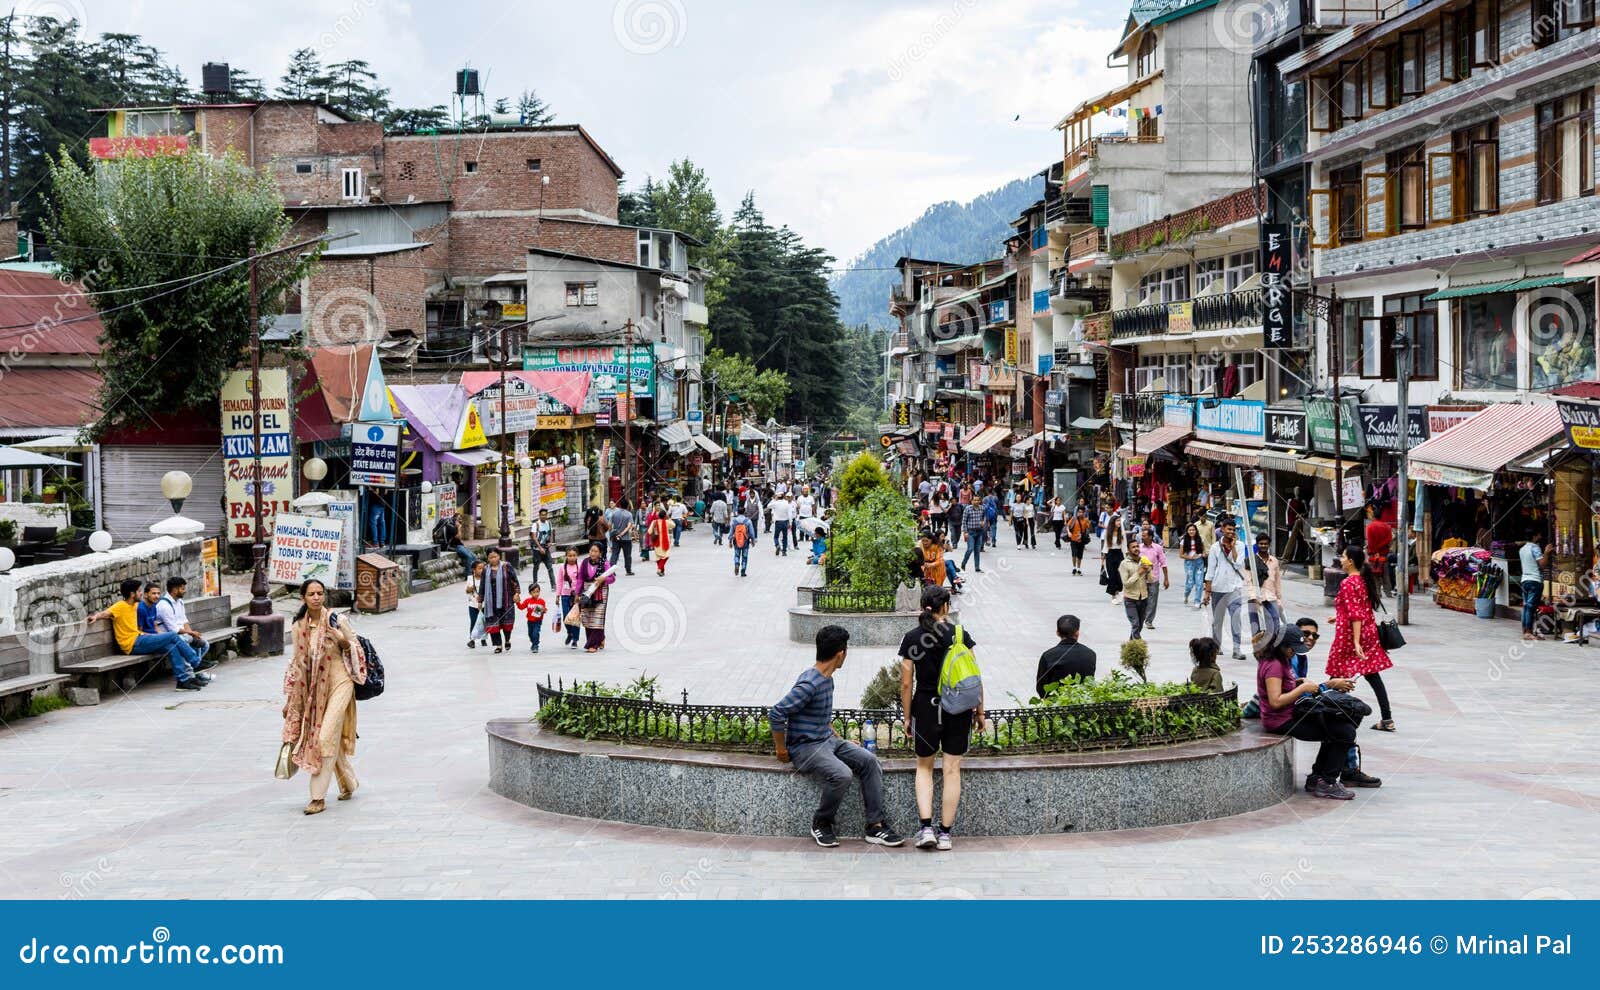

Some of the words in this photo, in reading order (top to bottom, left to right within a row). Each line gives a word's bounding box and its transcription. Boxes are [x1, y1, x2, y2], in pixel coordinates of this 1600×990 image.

[557, 347, 615, 364] GURU
[582, 364, 624, 375] AYURVEDA
[224, 400, 255, 411] HIMACHA
[232, 414, 281, 430] HOEL
[1272, 415, 1300, 440] EMERGE
[1364, 413, 1420, 434] Kashir
[353, 460, 369, 469] STATE
[369, 461, 384, 471] BANK
[384, 462, 396, 471] ATM
[276, 525, 309, 537] HIMACHAL
[312, 528, 340, 541] TOURISM
[276, 537, 337, 552] WELCOME
[279, 548, 302, 559] TODAYS
[306, 551, 332, 562] SPECIAL
[273, 560, 304, 571] TROUT
[276, 570, 297, 580] FISH
